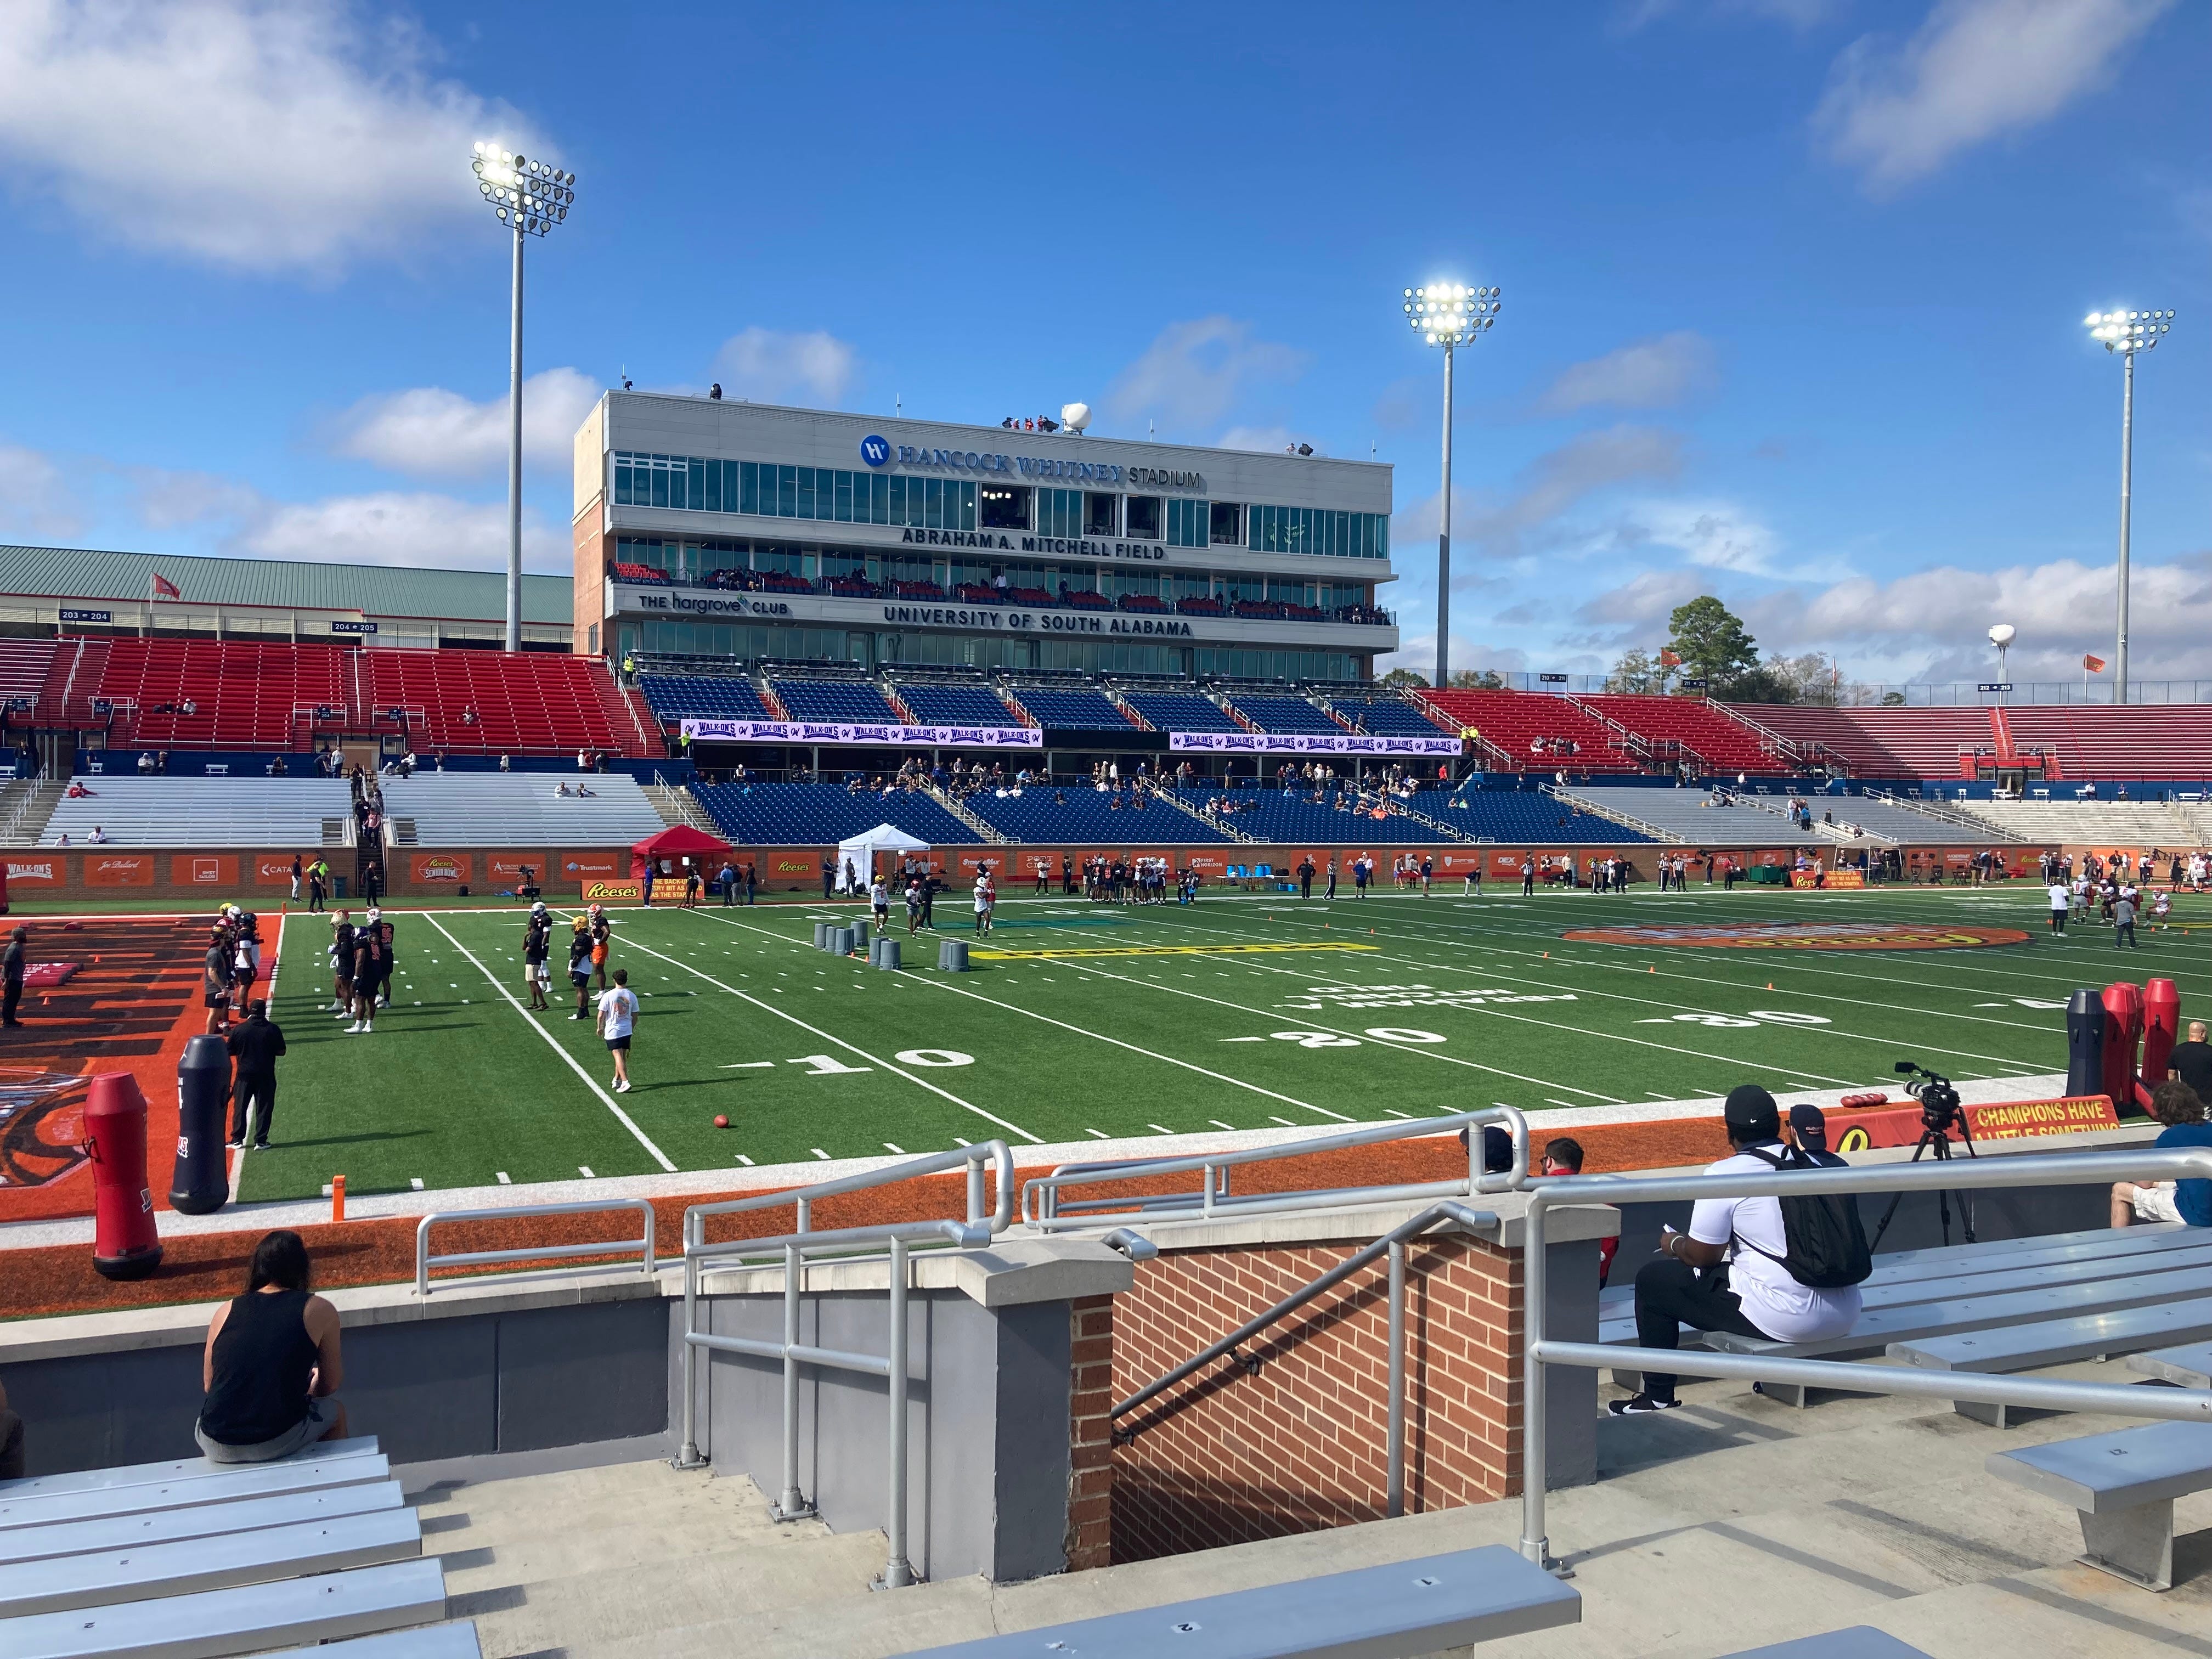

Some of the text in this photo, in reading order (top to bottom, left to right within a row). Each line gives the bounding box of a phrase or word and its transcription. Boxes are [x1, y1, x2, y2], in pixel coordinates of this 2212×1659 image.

[898, 445, 1200, 488] HANCOCK WHITNEY STADIUM
[902, 528, 1164, 560] ABRAHAM A. MITCHELL FIELD
[639, 591, 787, 614] THE hargrove CLUB
[884, 606, 1191, 636] UNIVERSITY OF SOUTH ALABAMA
[98, 860, 140, 871] Joe Bullard
[777, 861, 810, 872] Reese's
[425, 867, 459, 879] SENIOR BOWL
[587, 882, 639, 899] Reese's
[381, 927, 392, 943] 95
[1285, 988, 1518, 1001] MITCHELL
[1306, 984, 1436, 992] FIELD
[1977, 1101, 2106, 1127] CHAMPIONS HAVE
[1724, 1342, 1730, 1352] 4
[1178, 1623, 1193, 1632] 2
